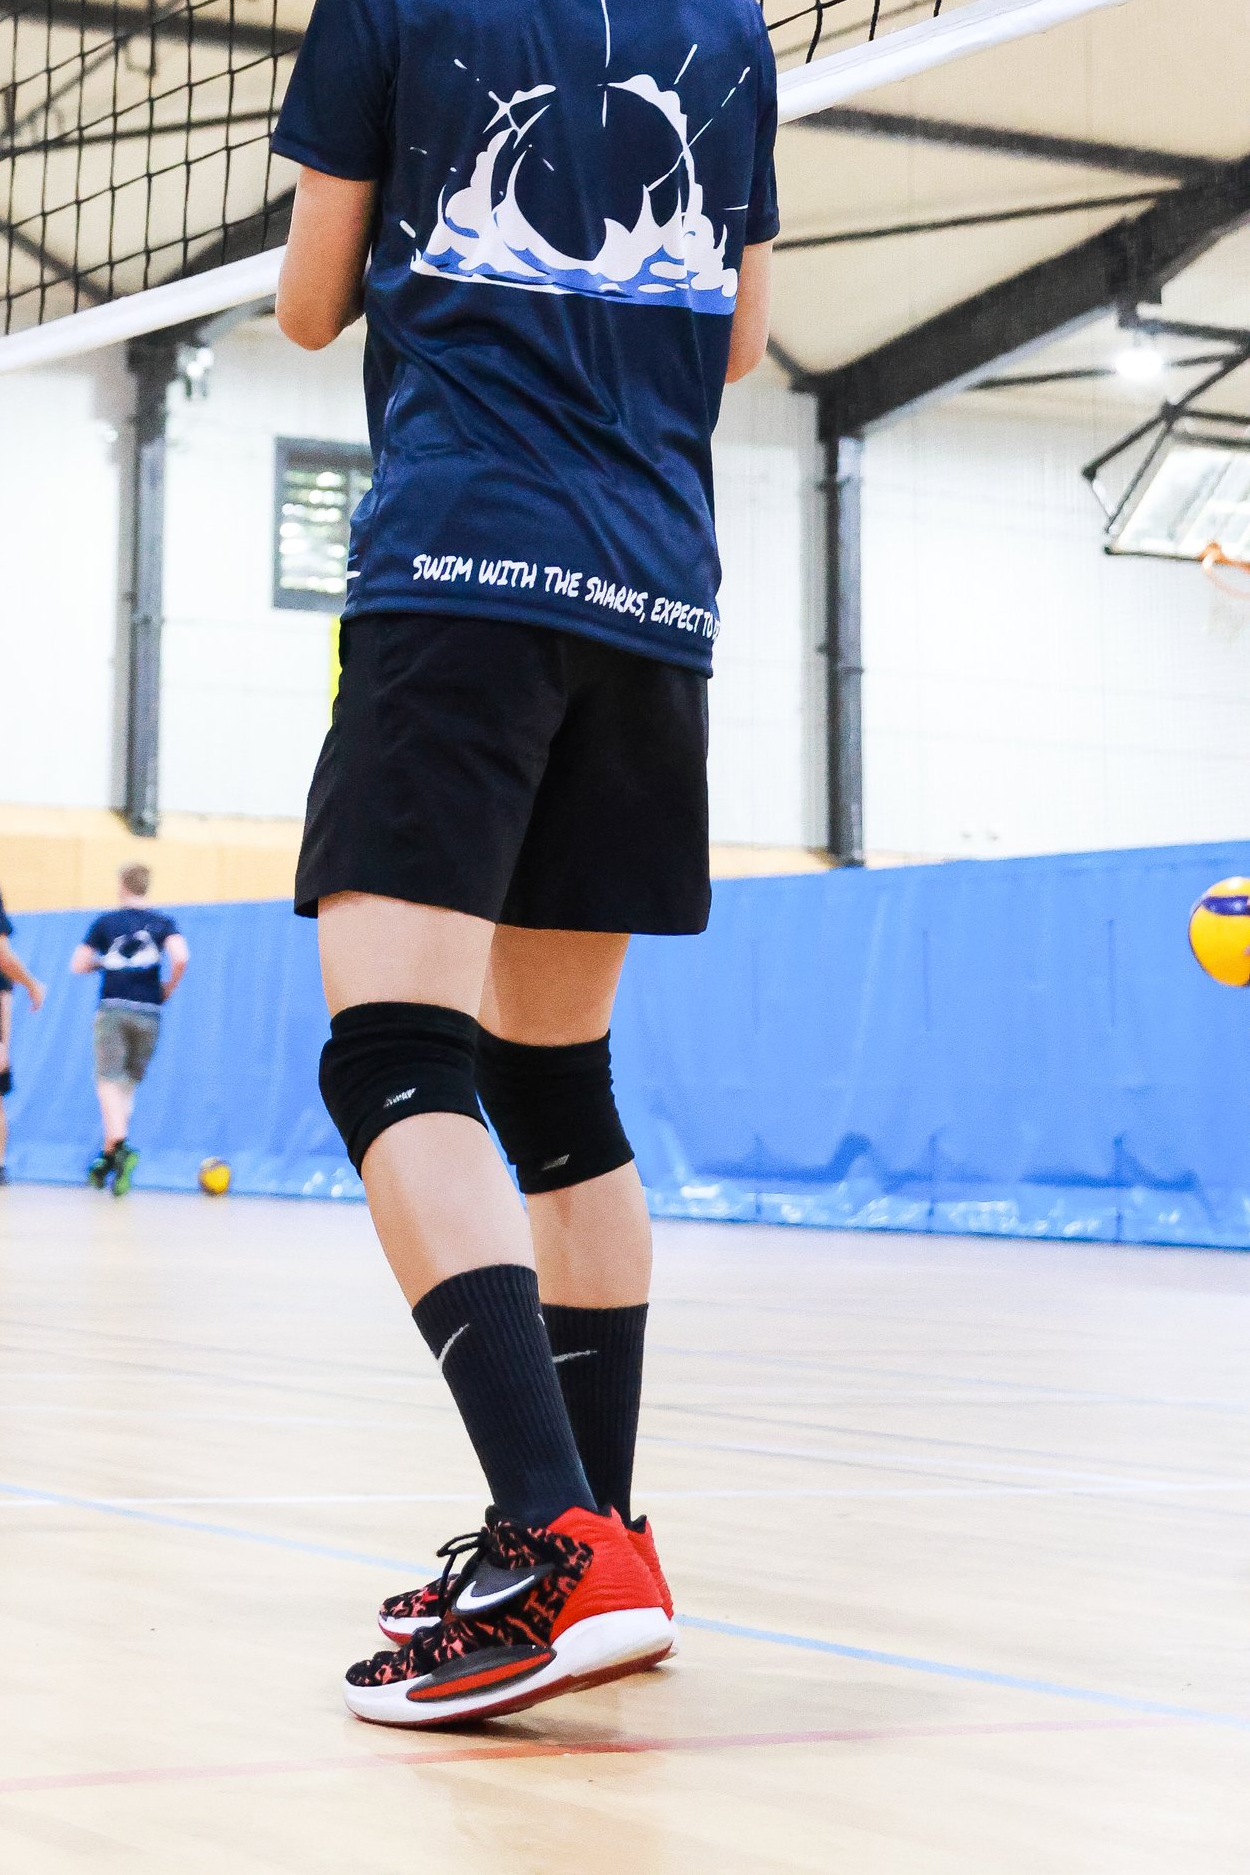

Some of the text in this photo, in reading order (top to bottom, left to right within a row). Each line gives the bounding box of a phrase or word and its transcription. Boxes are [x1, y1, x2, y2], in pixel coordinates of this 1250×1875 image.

[412, 553, 473, 583] SWIM
[478, 559, 537, 589] WITH
[543, 566, 583, 598] THE
[584, 576, 648, 623] SHARKS,
[650, 596, 704, 634] EXPECT
[702, 611, 713, 639] TO
